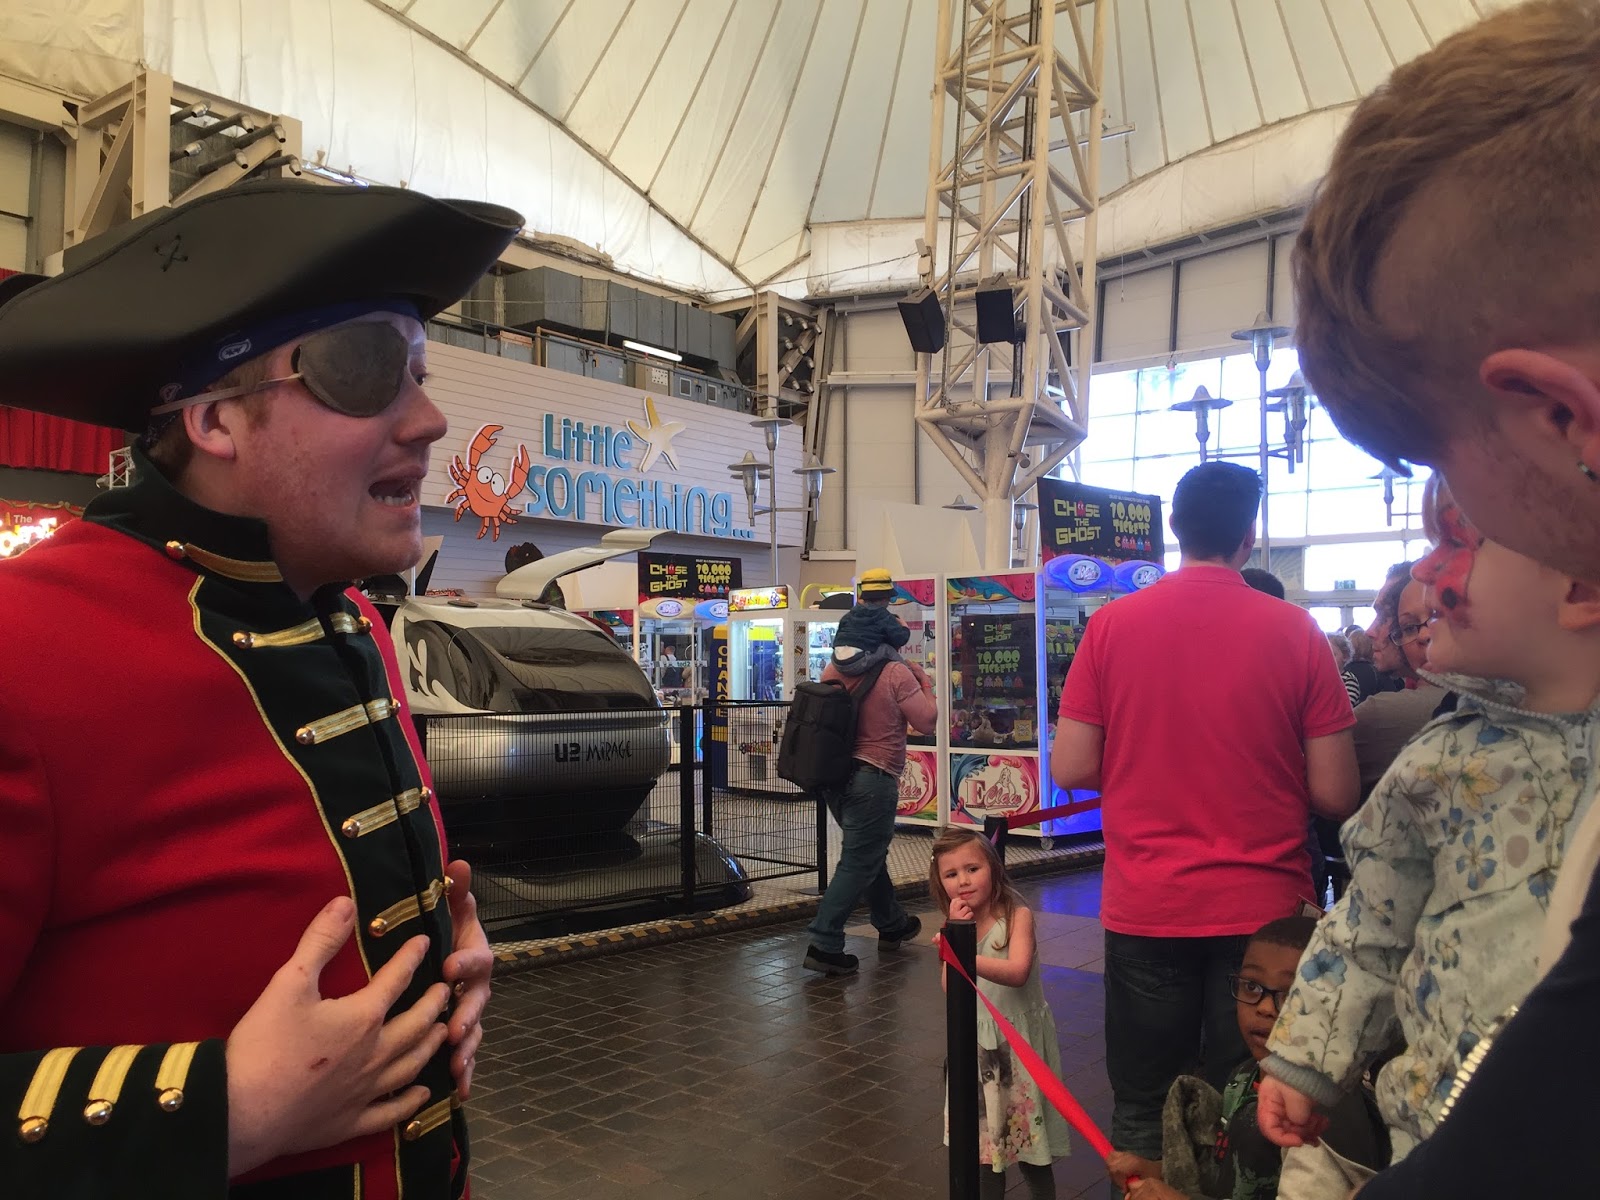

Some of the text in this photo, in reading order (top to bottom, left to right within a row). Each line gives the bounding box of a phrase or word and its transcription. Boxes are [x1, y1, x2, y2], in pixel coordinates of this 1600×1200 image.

[543, 413, 633, 470] Little
[1053, 499, 1101, 518] CHSE
[1109, 501, 1151, 523] 10,000
[13, 514, 33, 523] The
[1074, 517, 1090, 527] THE
[1112, 518, 1150, 535] TICKETS
[1055, 526, 1102, 545] GHOST
[649, 563, 688, 575] CHSE
[695, 563, 732, 576] 10,000
[697, 574, 731, 584] TICKETS
[649, 579, 688, 593] GHOST
[984, 623, 1012, 632] CHSE
[984, 633, 1012, 644] GHOST
[976, 649, 1020, 664] 10,000
[978, 661, 1019, 673] TICKETS
[554, 742, 580, 763] U2
